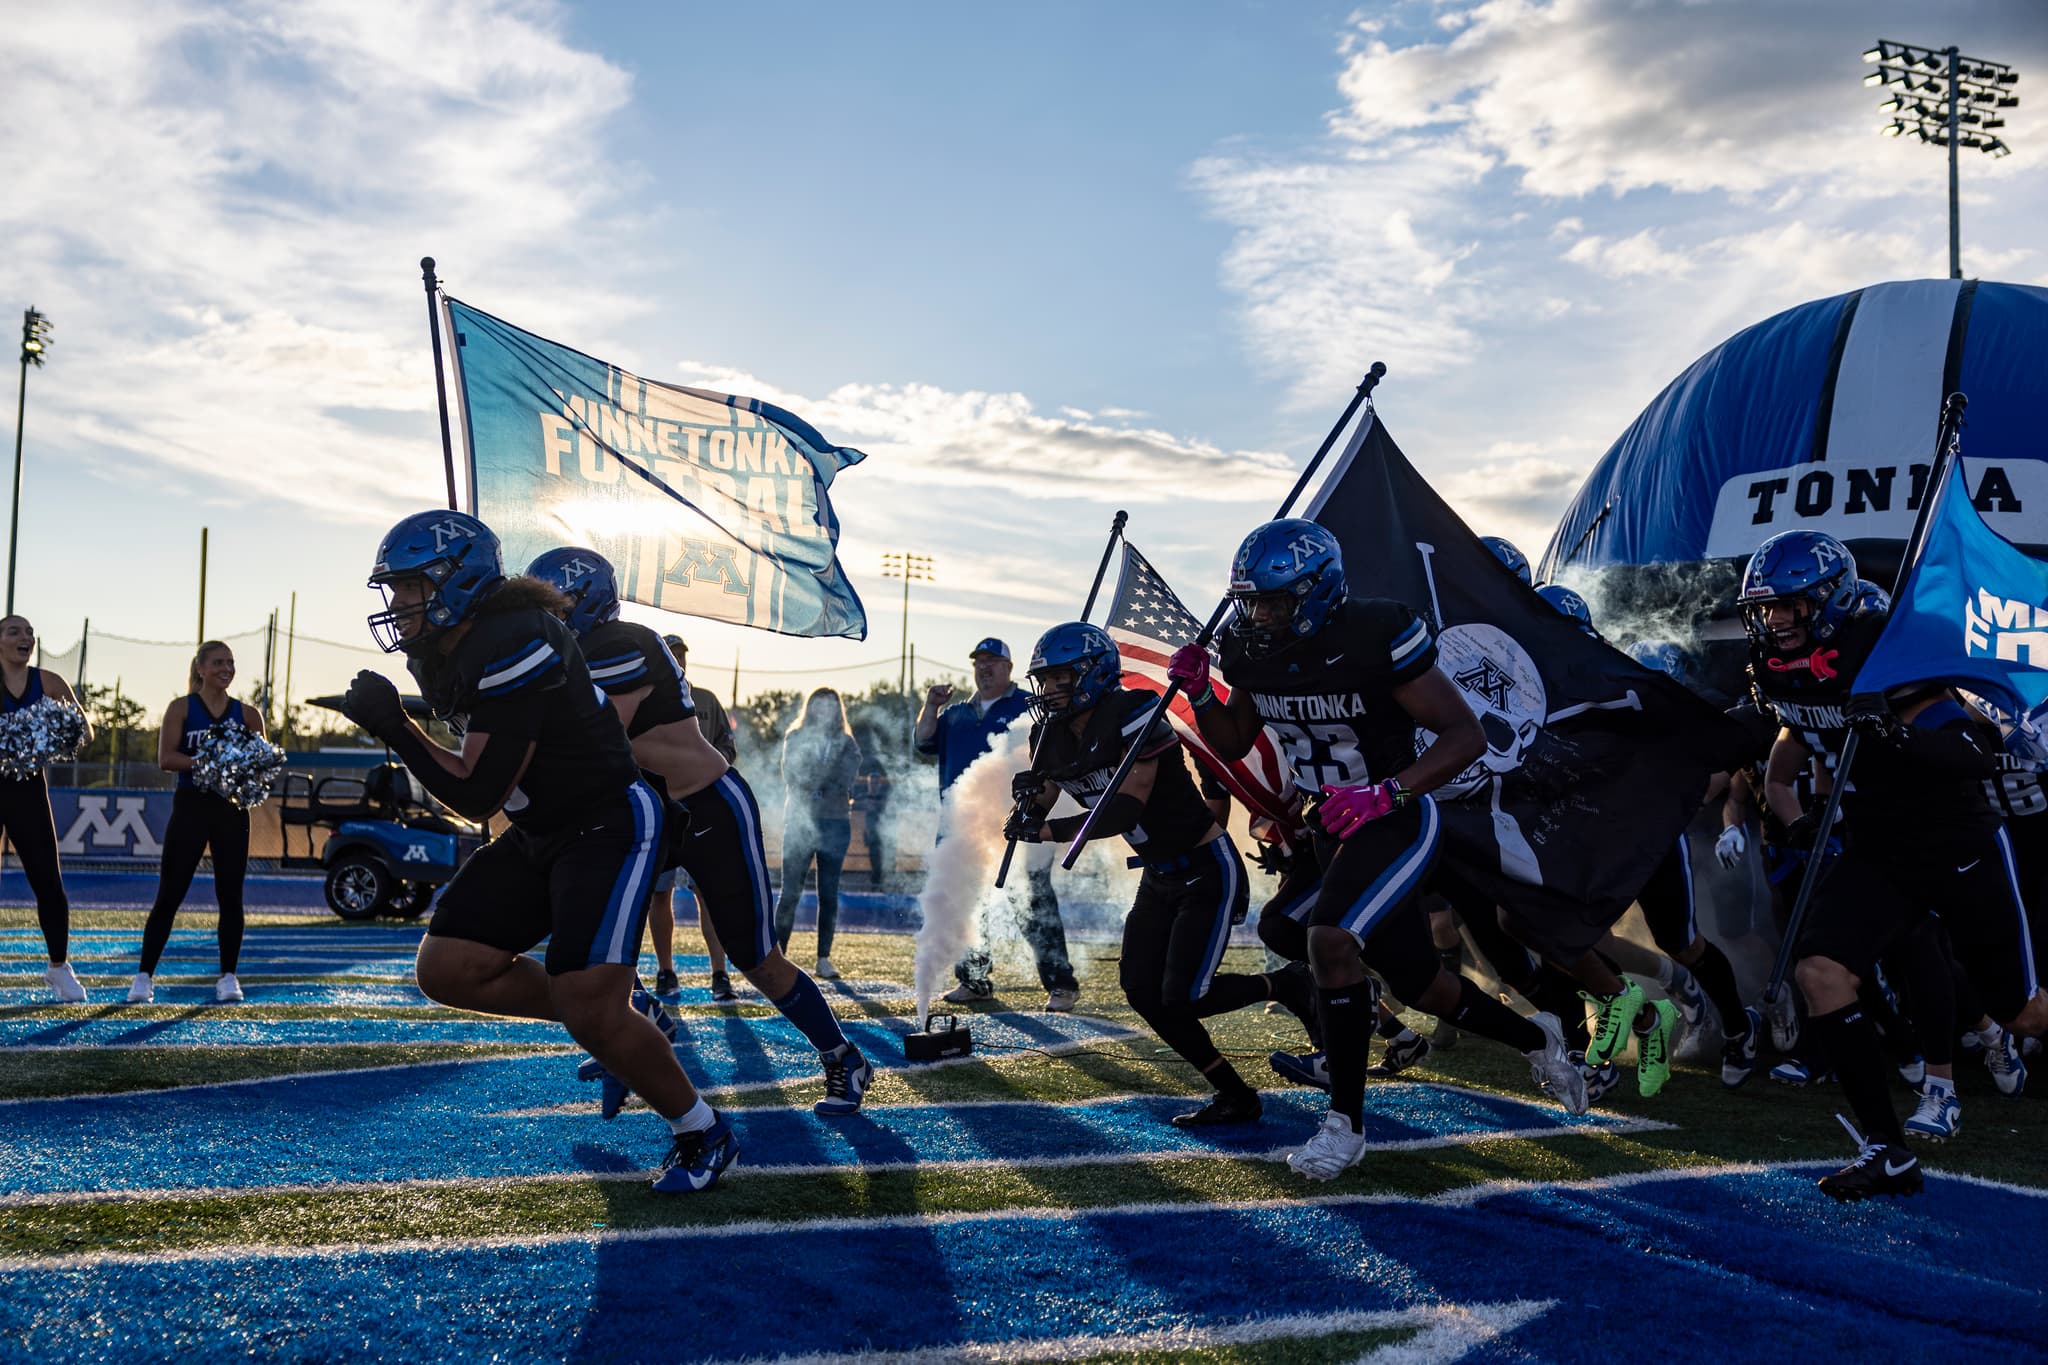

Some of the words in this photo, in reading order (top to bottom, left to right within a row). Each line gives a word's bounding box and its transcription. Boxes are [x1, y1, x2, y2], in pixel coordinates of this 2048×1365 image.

[429, 518, 477, 553] M
[1287, 534, 1327, 573] M
[560, 557, 596, 589] M
[664, 538, 751, 597] M
[1809, 541, 1848, 575] M
[1453, 656, 1516, 714] M
[1250, 691, 1367, 721] MINNETONKA
[1263, 722, 1371, 794] 23
[1983, 772, 2048, 817] 16
[58, 795, 164, 856] M
[403, 844, 431, 863] M
